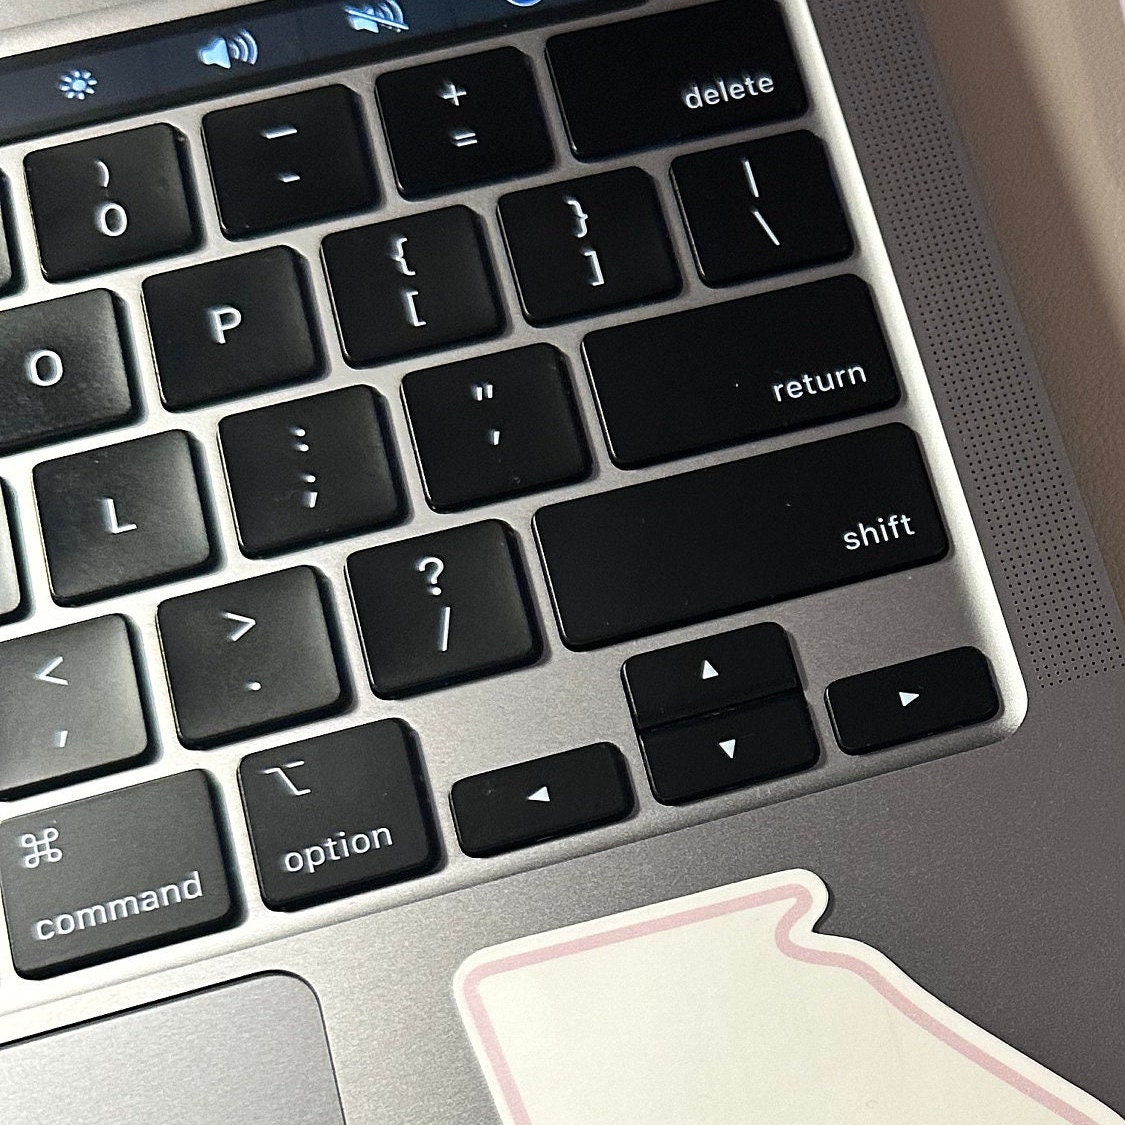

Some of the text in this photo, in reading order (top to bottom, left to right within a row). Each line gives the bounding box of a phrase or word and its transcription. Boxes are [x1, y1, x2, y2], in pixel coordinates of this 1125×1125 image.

[441, 83, 467, 106] +
[685, 77, 774, 108] delete
[453, 132, 478, 147] =
[94, 160, 110, 188] )
[96, 202, 128, 237] 0
[209, 306, 242, 345] P
[25, 349, 64, 387] O
[774, 367, 866, 401] return
[102, 498, 138, 534] L
[844, 515, 915, 550] shift
[416, 556, 444, 596] ?
[284, 828, 392, 873] option
[34, 871, 203, 941] command
